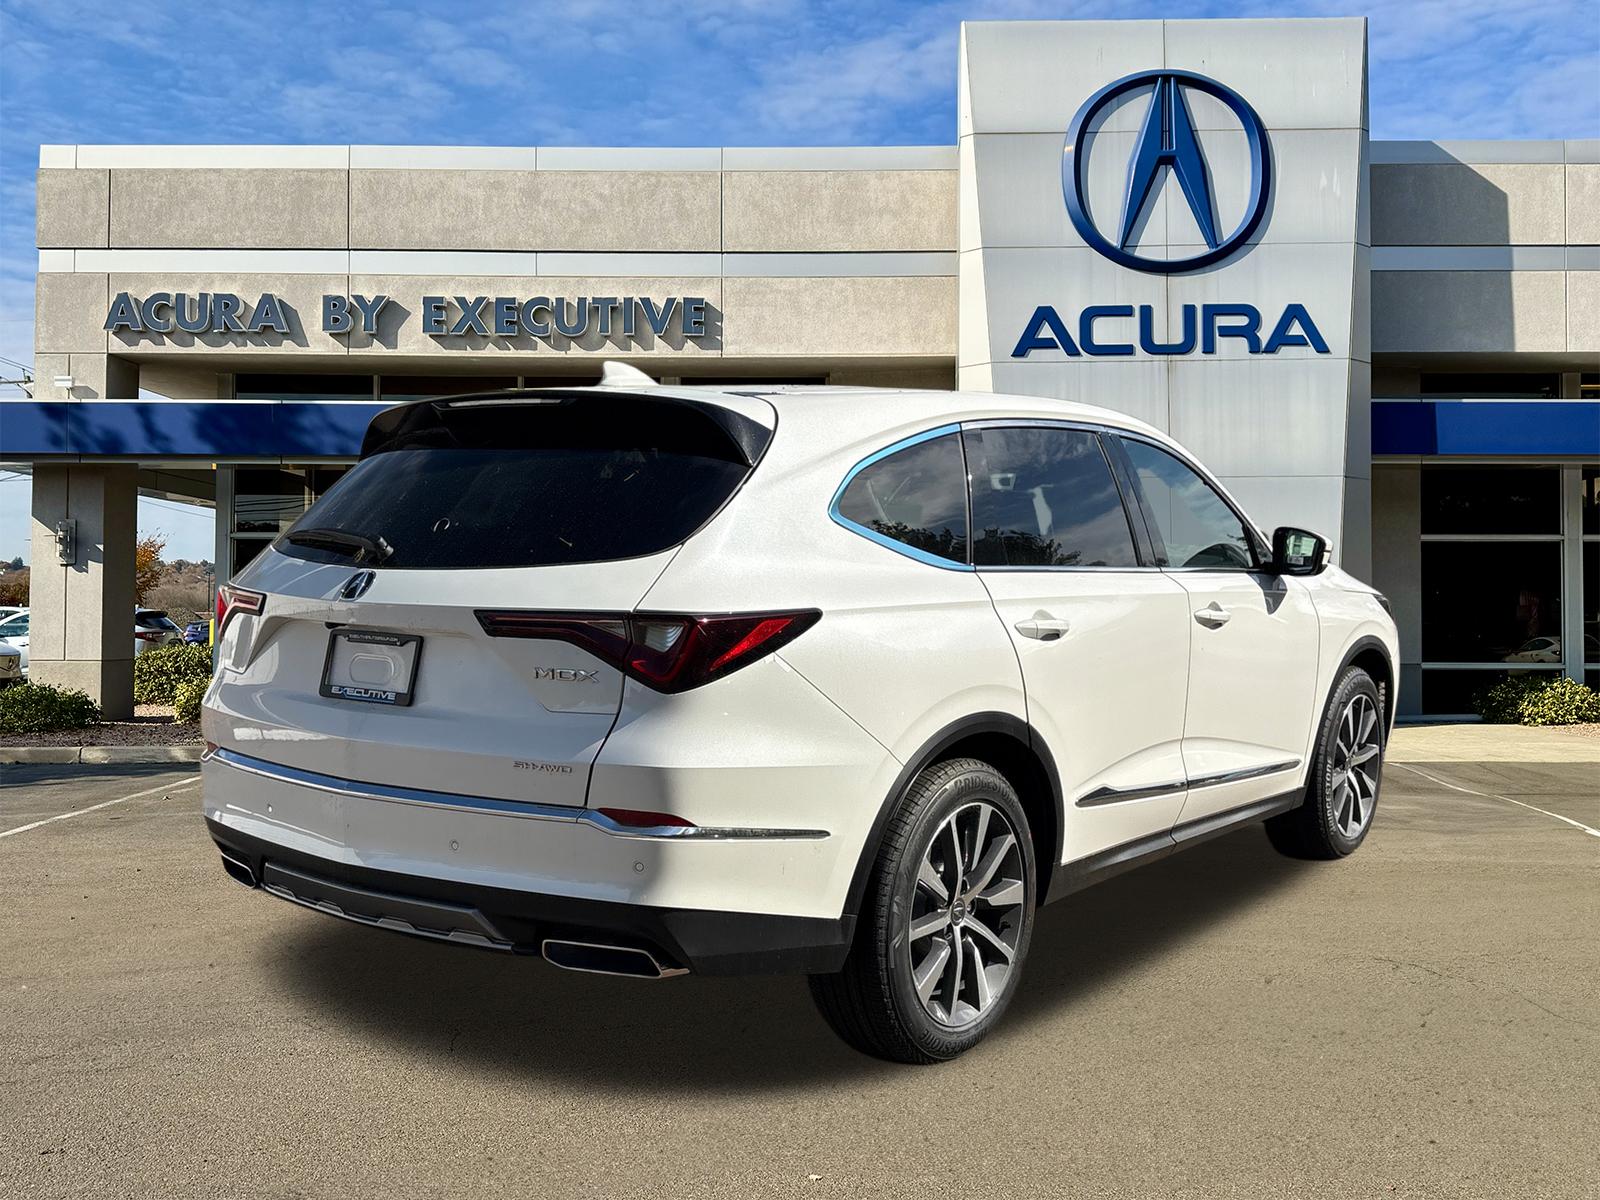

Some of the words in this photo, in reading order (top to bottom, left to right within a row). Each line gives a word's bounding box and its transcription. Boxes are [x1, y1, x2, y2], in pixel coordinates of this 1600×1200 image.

[104, 292, 288, 333] ACURA
[322, 294, 390, 334] BY
[422, 296, 707, 337] EXECUTIVE
[1011, 303, 1332, 357] ACURA
[534, 667, 601, 683] MDX
[331, 686, 396, 701] EXECUTIVE
